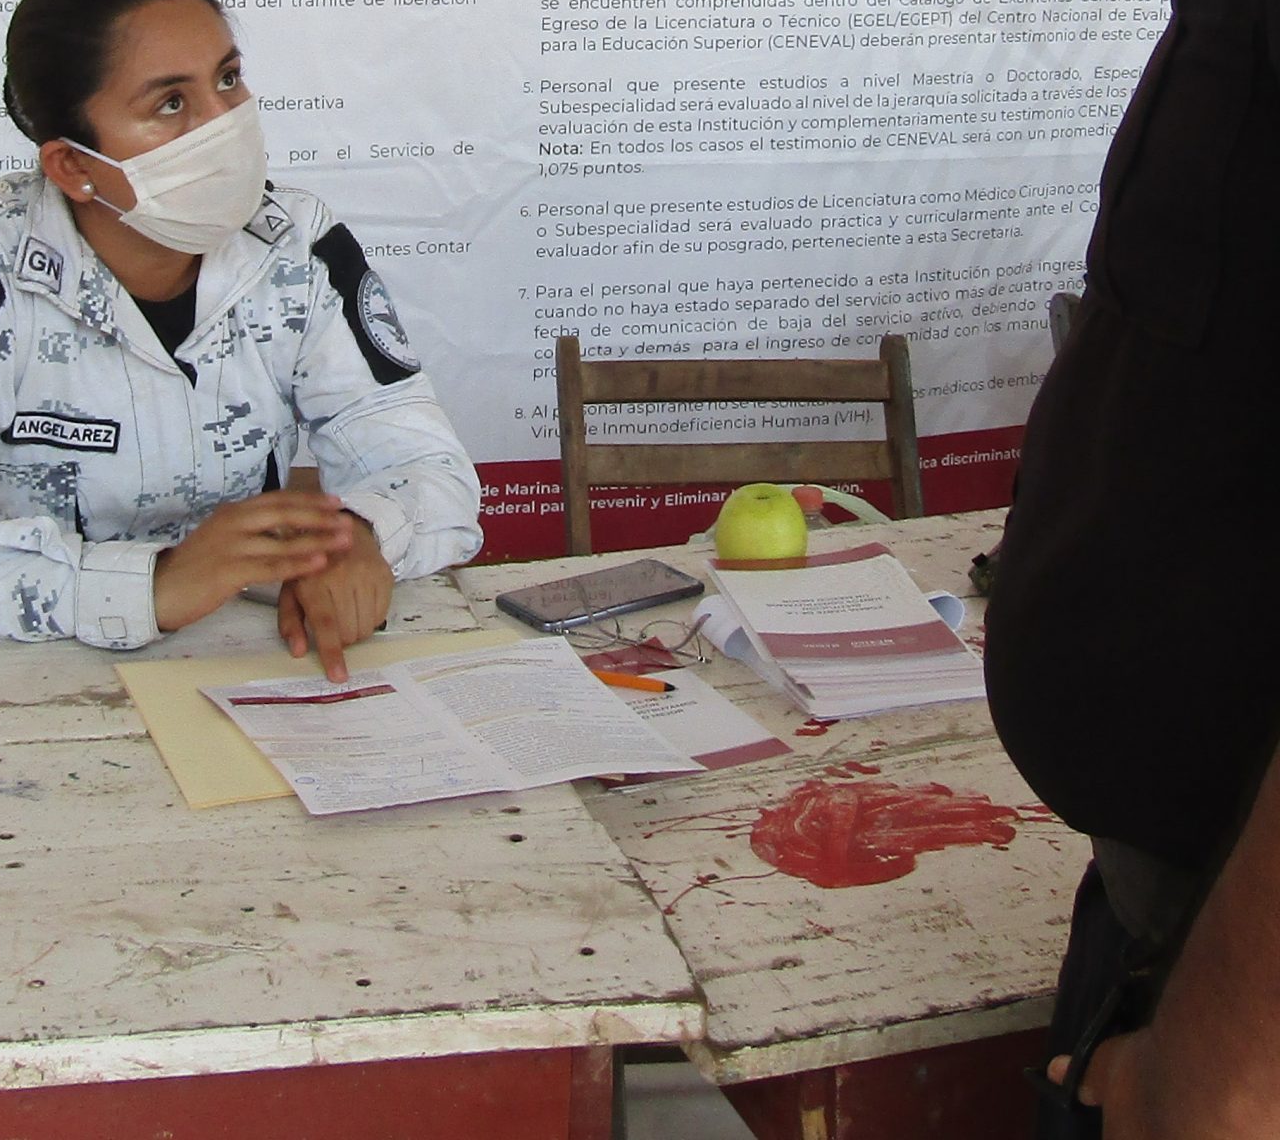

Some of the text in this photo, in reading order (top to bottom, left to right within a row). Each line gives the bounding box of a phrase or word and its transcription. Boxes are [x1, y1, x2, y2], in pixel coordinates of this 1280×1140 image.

[28, 250, 61, 281] GN
[17, 420, 113, 443] ANGELAREZ
[602, 408, 874, 435] Inmunodeficiencia Humana (VIH).
[480, 484, 500, 497] de
[588, 495, 646, 510] revenir
[650, 497, 661, 509] y
[664, 490, 726, 507] Eliminar
